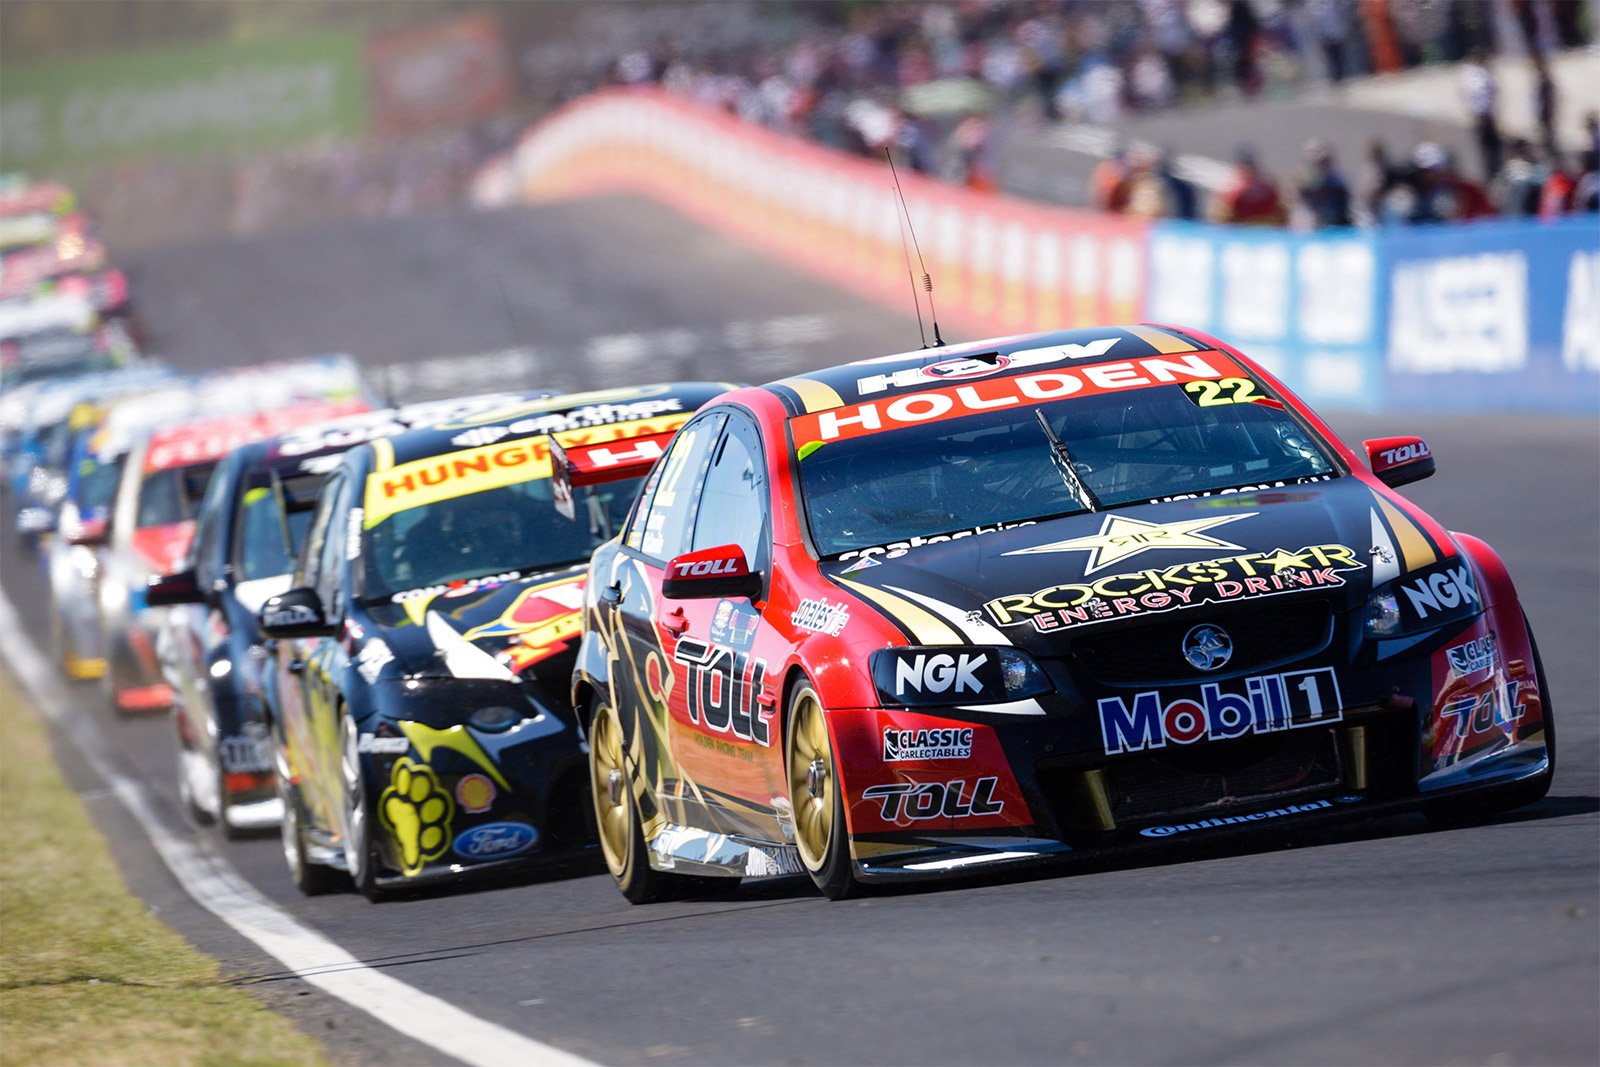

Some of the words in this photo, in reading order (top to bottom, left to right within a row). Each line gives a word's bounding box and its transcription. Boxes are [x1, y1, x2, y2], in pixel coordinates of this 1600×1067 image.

[818, 354, 1222, 441] HOLDEN
[1184, 377, 1267, 407] 22
[1379, 441, 1431, 465] TOLL
[675, 558, 738, 577] TOLL
[1034, 586, 1194, 630] ENERGY
[1214, 567, 1340, 598] DRINK
[1401, 565, 1479, 619] NGK
[674, 636, 770, 748] TOLL
[896, 653, 988, 695] NGK
[1098, 674, 1287, 756] Mobil
[1440, 680, 1526, 738] TOLL
[900, 728, 973, 749] CLASSIC
[900, 748, 971, 760] CARLECTABLES
[862, 776, 1005, 822] TOLL
[1138, 799, 1334, 838] Continental
[467, 829, 519, 855] Ford
